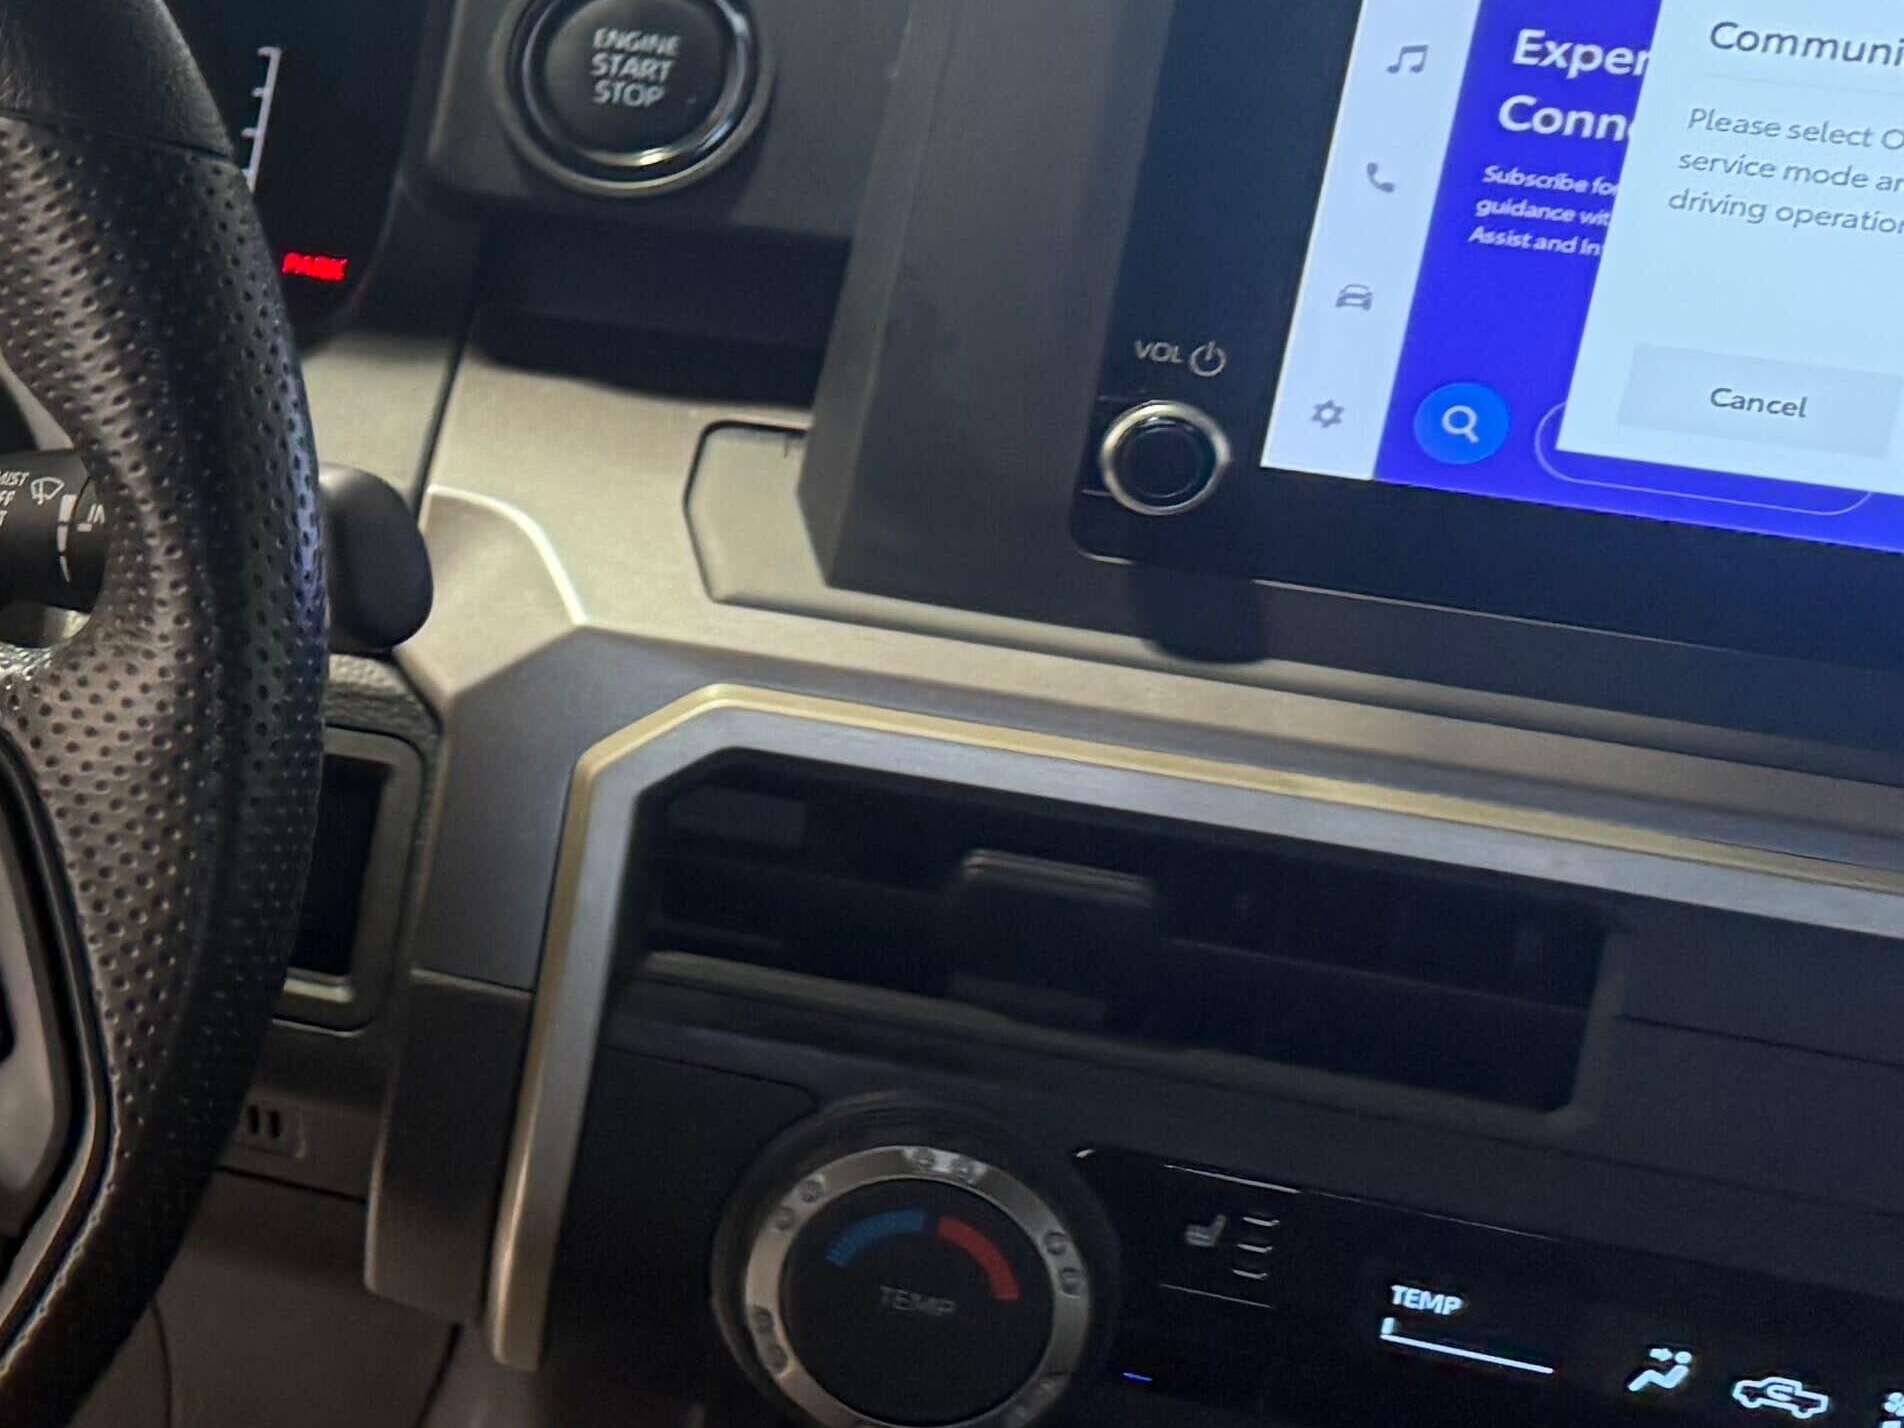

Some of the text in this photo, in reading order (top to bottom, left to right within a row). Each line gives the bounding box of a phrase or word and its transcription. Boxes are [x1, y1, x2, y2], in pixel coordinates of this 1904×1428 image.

[593, 28, 680, 56] ENGINE
[591, 53, 674, 82] START
[593, 79, 665, 107] STOP
[1498, 94, 1632, 142] Conn
[1687, 107, 1781, 139] Please
[1785, 120, 1874, 149] select
[1482, 163, 1589, 194] Subscribe
[1677, 153, 1778, 179] service
[1782, 164, 1871, 189] mode
[1473, 197, 1576, 224] guidance
[1668, 187, 1767, 225] driving
[1467, 224, 1534, 250] Assist
[1533, 235, 1578, 255] and
[1134, 339, 1183, 363] VOL
[1709, 386, 1808, 420] Cancel
[879, 1284, 957, 1317] TEMP
[1390, 1284, 1464, 1316] TEMP
